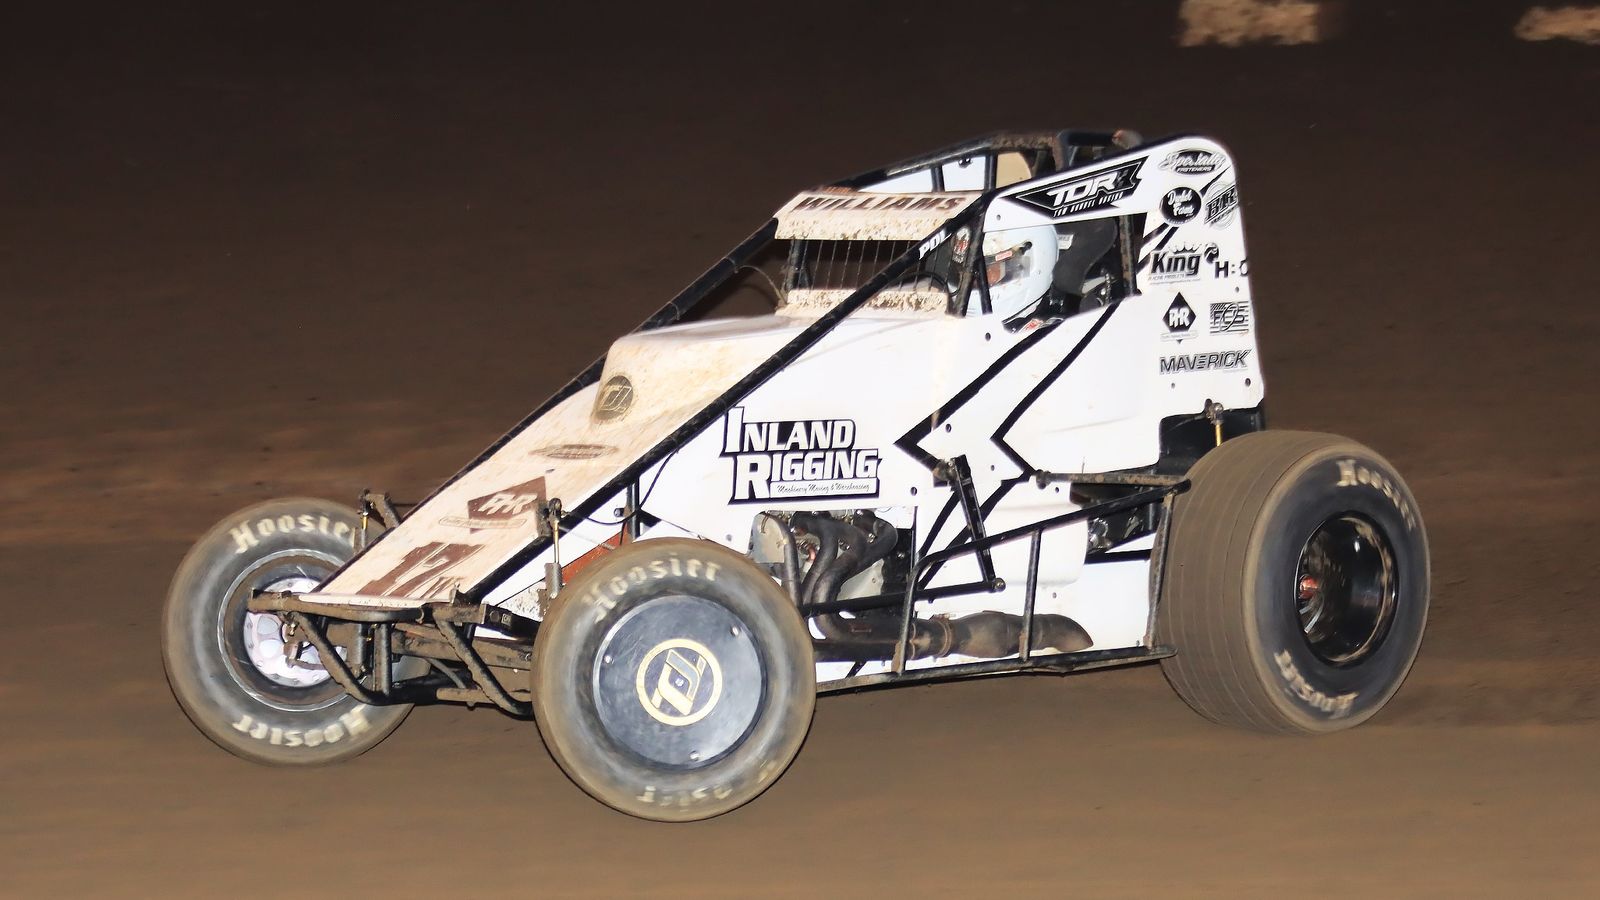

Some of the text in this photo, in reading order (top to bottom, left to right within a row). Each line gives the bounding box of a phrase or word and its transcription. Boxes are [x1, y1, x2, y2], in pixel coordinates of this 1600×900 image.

[1046, 171, 1118, 206] TDR
[790, 196, 968, 213] WILLIAMS
[1151, 252, 1202, 277] King
[1159, 348, 1251, 374] MAVERICK
[723, 406, 856, 455] INLAND
[732, 449, 880, 502] RIGGING
